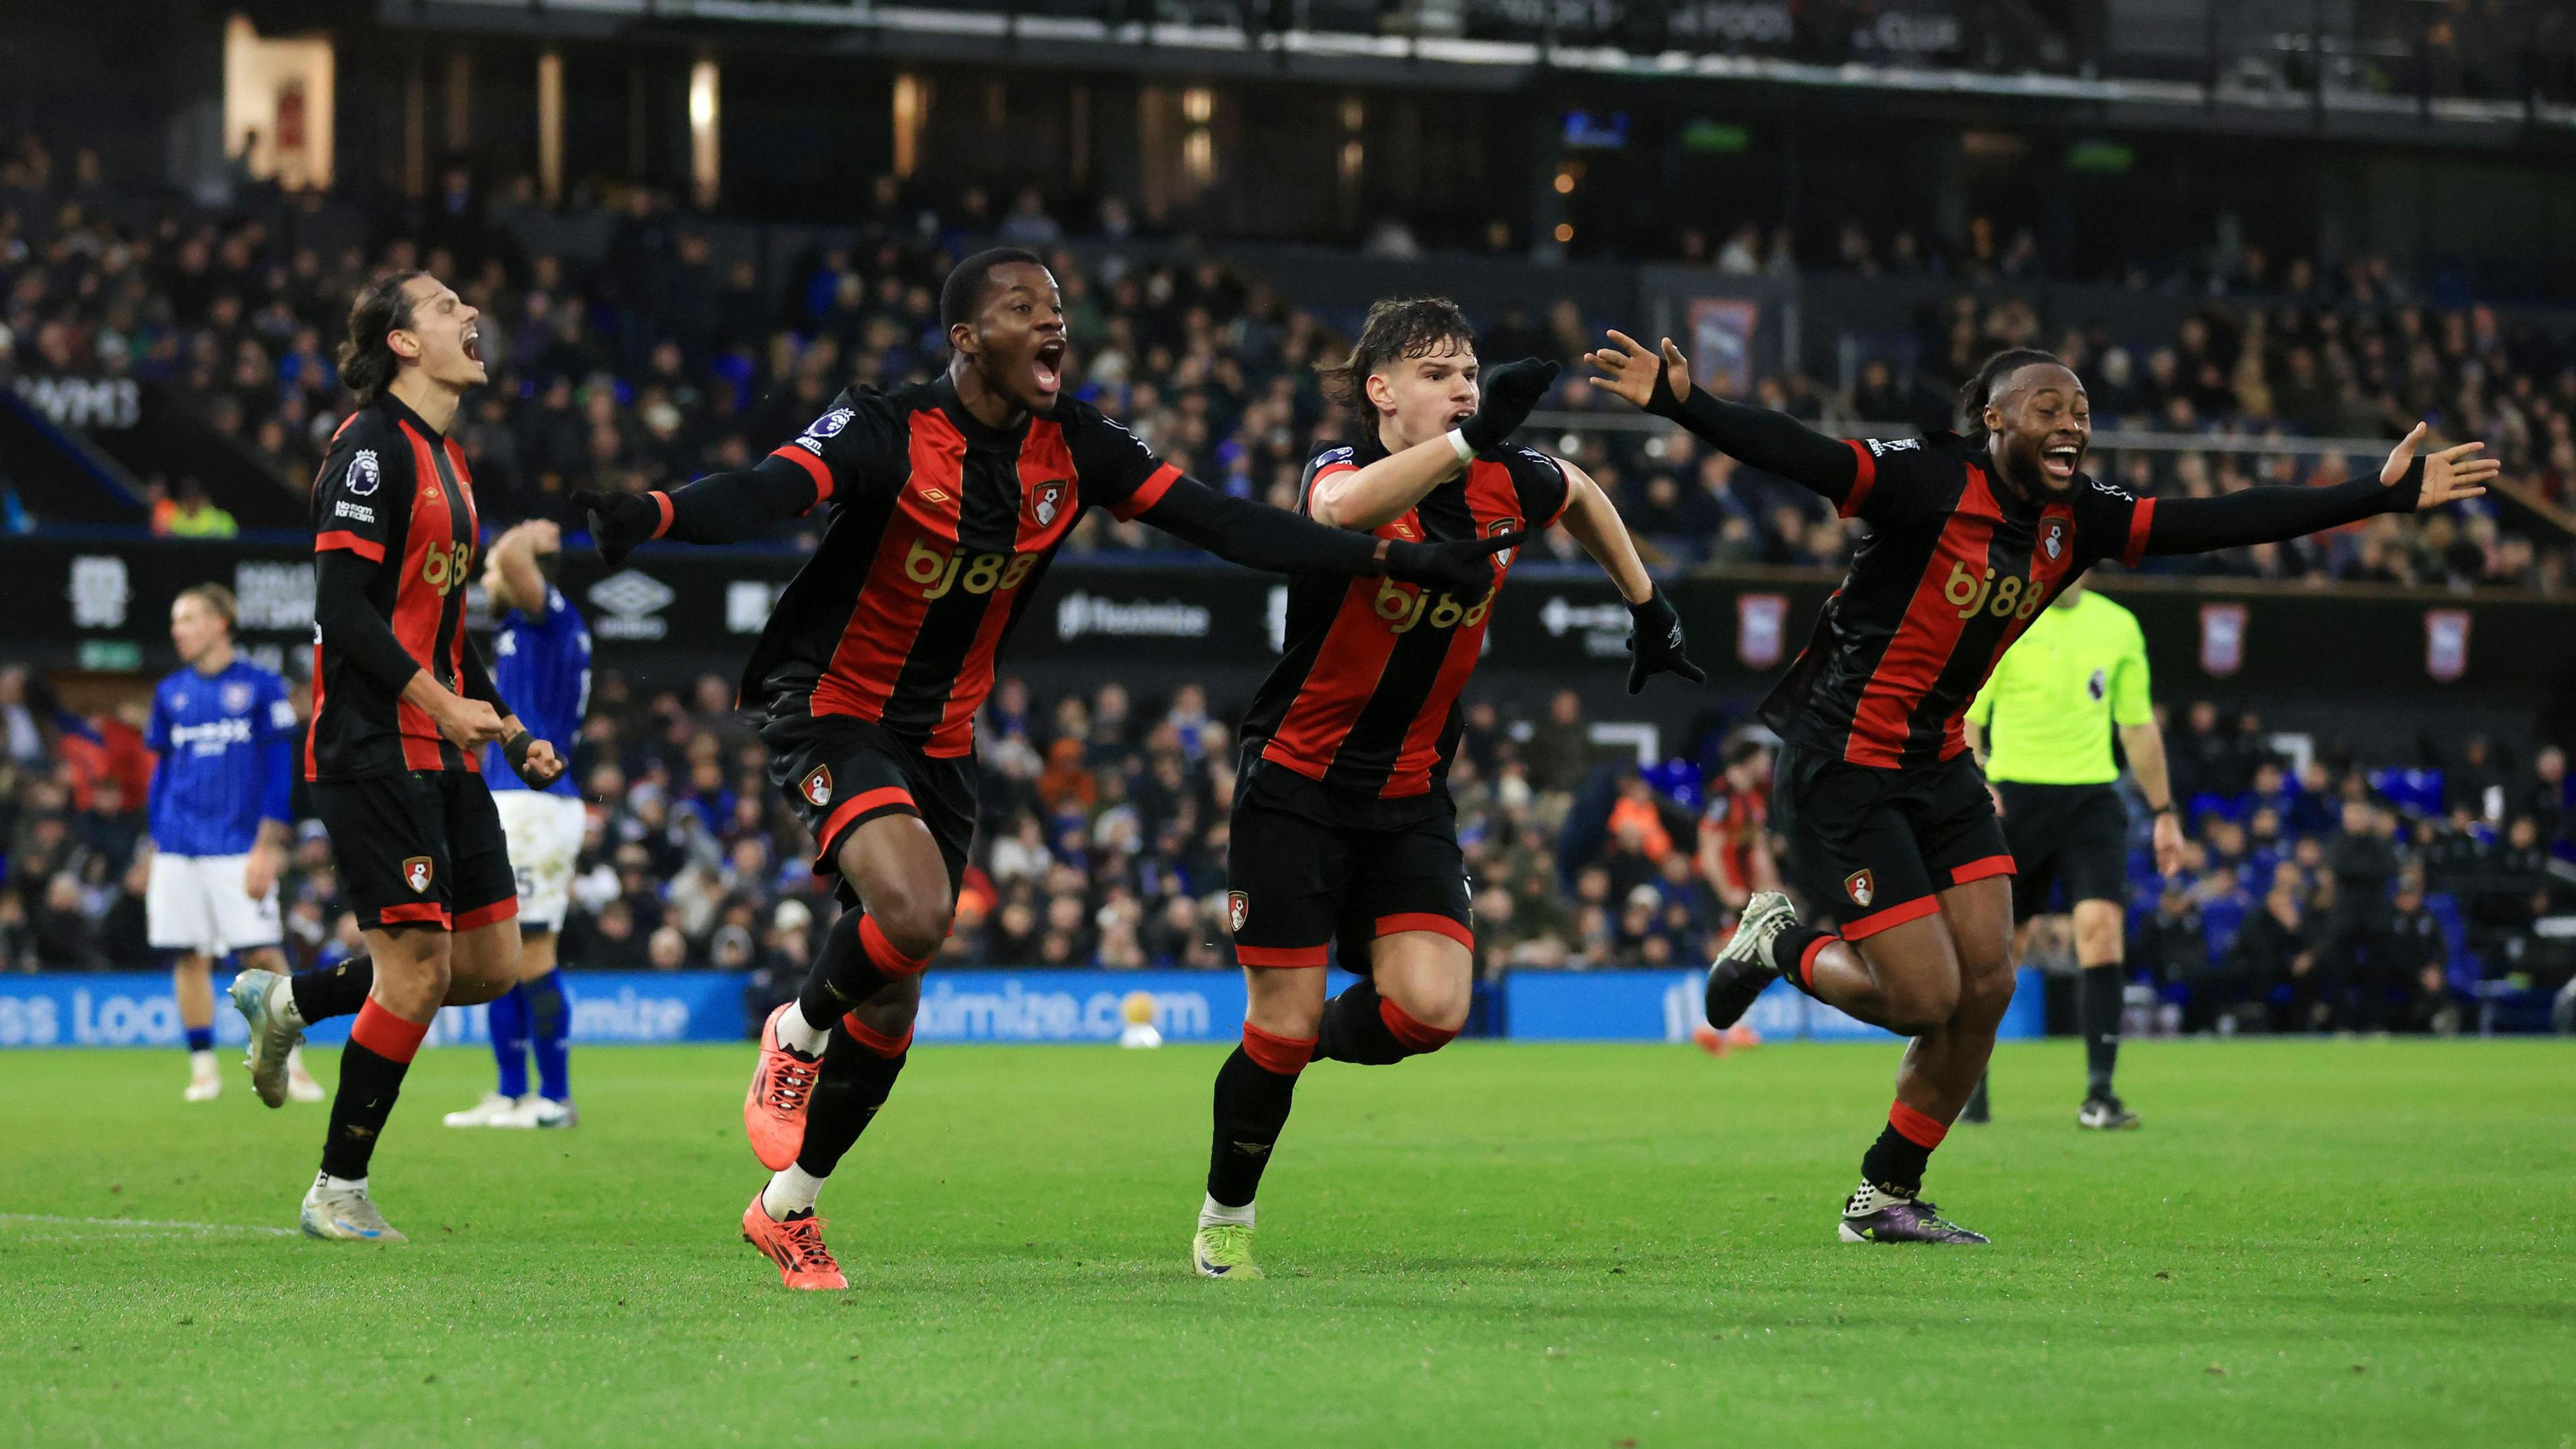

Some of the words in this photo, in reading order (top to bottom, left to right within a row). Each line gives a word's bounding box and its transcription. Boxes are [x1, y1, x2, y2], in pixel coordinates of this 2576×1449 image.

[336, 500, 350, 511] No
[423, 541, 473, 596] bj8
[904, 538, 1038, 600] bj88
[1945, 561, 2043, 619] bj88
